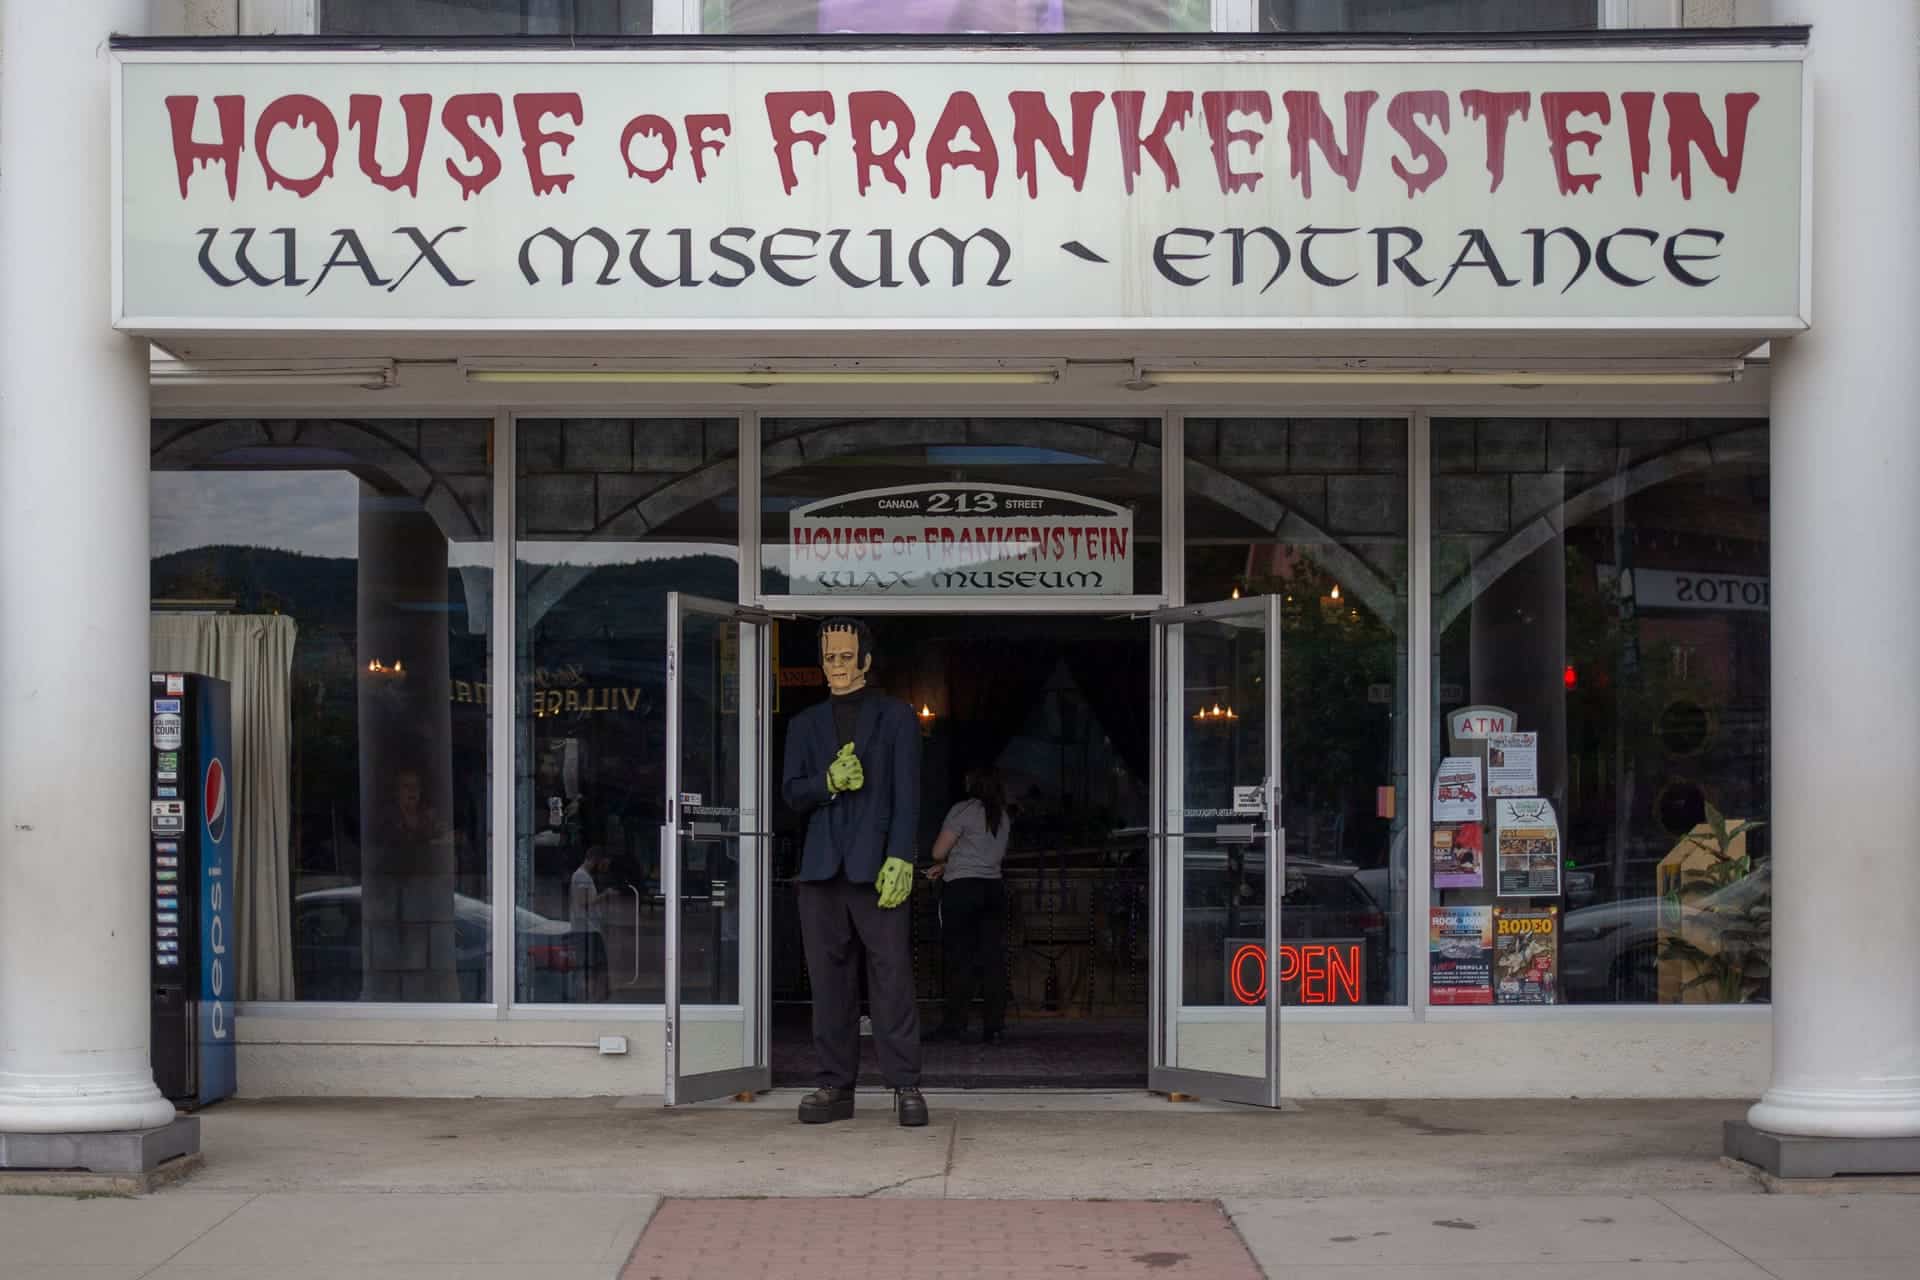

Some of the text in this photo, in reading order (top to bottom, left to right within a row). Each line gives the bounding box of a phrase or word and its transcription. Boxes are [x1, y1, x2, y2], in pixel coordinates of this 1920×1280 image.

[166, 90, 1760, 200] HOUSE OF FRANKENSTEIN
[196, 226, 475, 296] WAX
[518, 226, 1012, 288] MUSEUM
[1153, 224, 1725, 296] ENTRANCE
[878, 492, 1044, 513] CANADA 213 STREET
[793, 527, 1128, 563] HOUSE OF FRANKENSTEIN
[817, 569, 1103, 591] WAX MUSEUM
[155, 727, 180, 736] COUNT
[1461, 718, 1505, 733] ATM
[1497, 918, 1553, 934] RODEO
[208, 867, 226, 1039] pepsi
[1231, 944, 1360, 1004] OPEN
